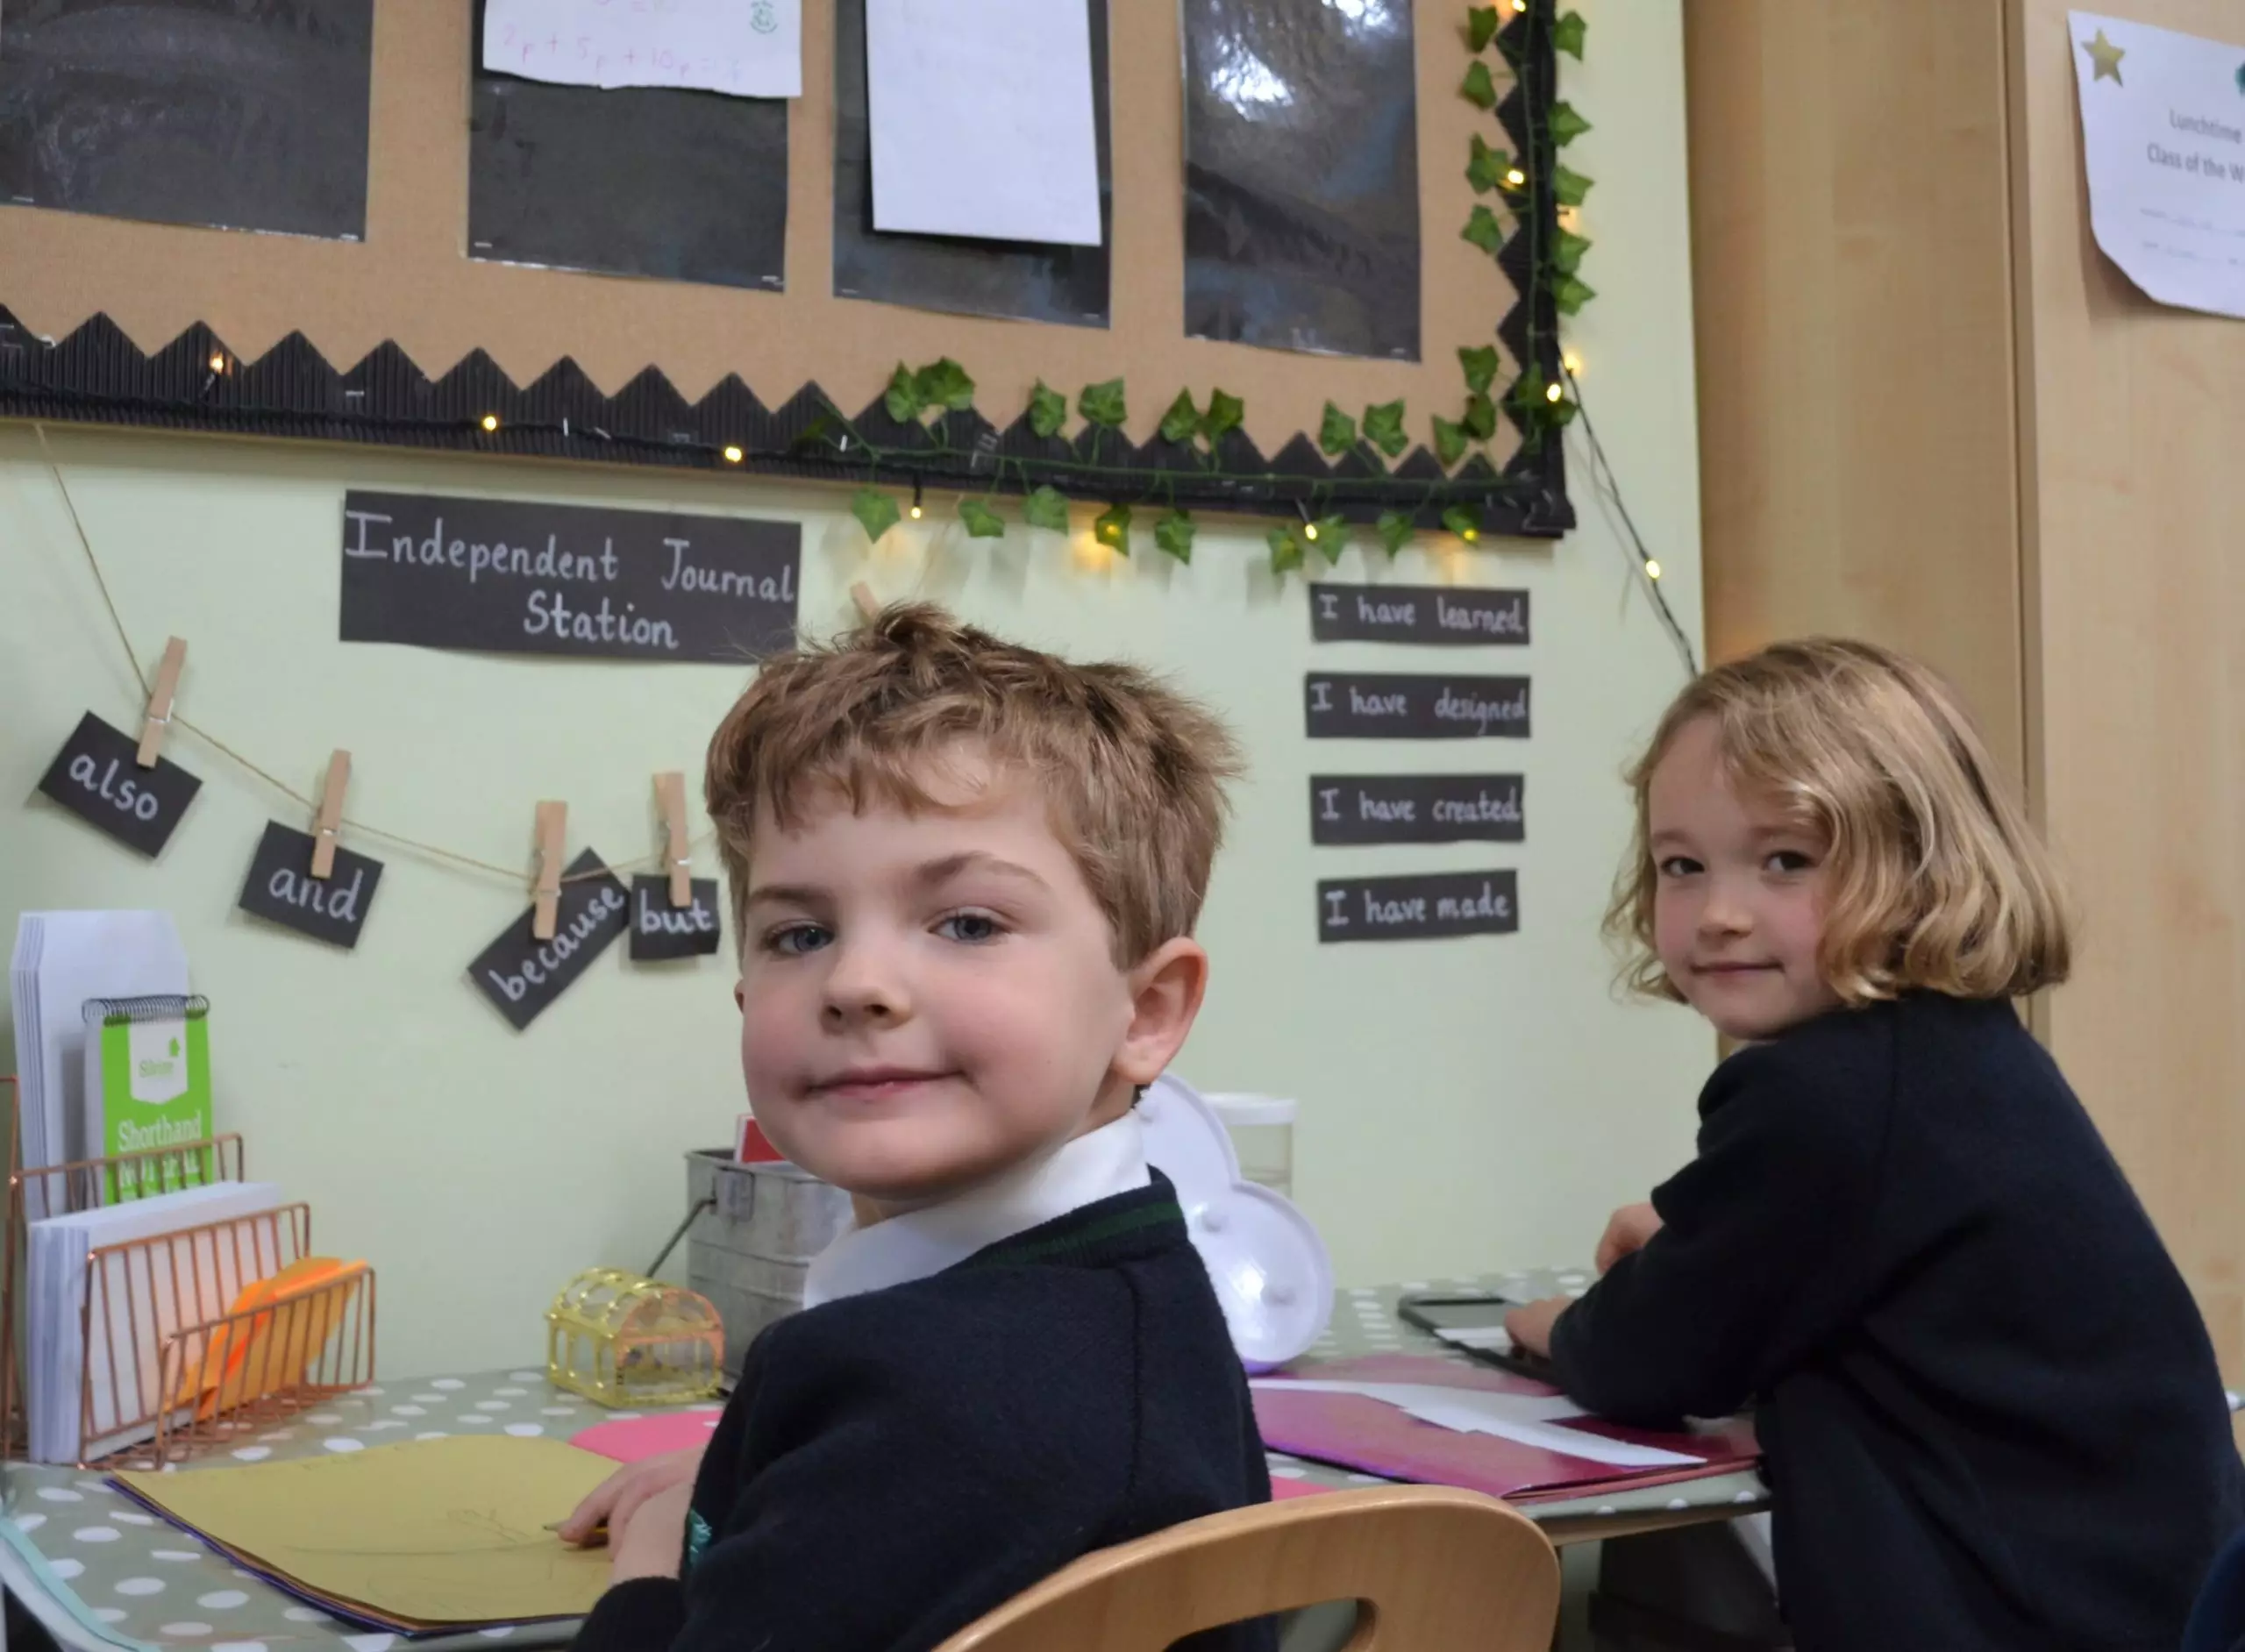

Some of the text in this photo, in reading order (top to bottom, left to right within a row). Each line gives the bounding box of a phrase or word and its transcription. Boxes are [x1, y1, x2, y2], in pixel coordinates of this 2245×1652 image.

[2168, 107, 2242, 144] Lunchtime
[2147, 142, 2182, 169] Class
[2185, 151, 2199, 173] of
[2203, 157, 2227, 180] the
[345, 509, 795, 602] Independent Journal
[524, 589, 679, 649] Station
[1319, 593, 1524, 635] I have learned
[1310, 681, 1527, 737] I have designed
[68, 753, 160, 821] also
[1318, 786, 1523, 824] I have created
[268, 867, 365, 922] and
[638, 887, 713, 936] but
[1324, 880, 1512, 927] I have made
[488, 886, 625, 1002] because
[118, 1108, 203, 1153] Shorthand
